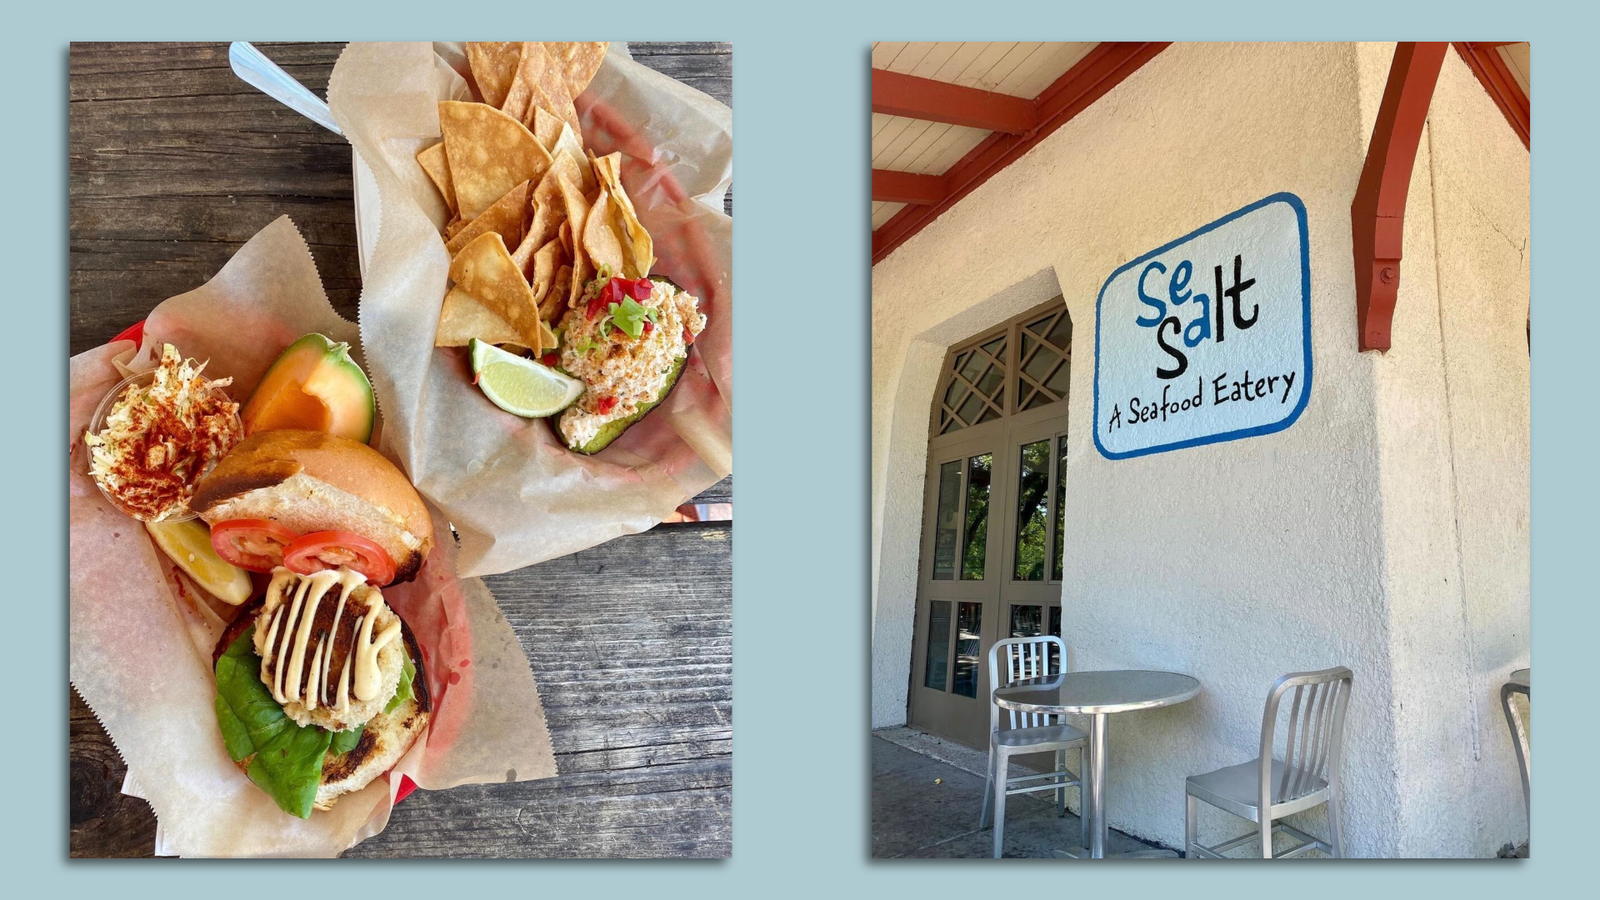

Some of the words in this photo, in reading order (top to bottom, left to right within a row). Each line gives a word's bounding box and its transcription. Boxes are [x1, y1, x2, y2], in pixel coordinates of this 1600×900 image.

[1108, 403, 1122, 433] A
[1127, 375, 1203, 425] Seafood
[1212, 370, 1296, 406] Eatery
